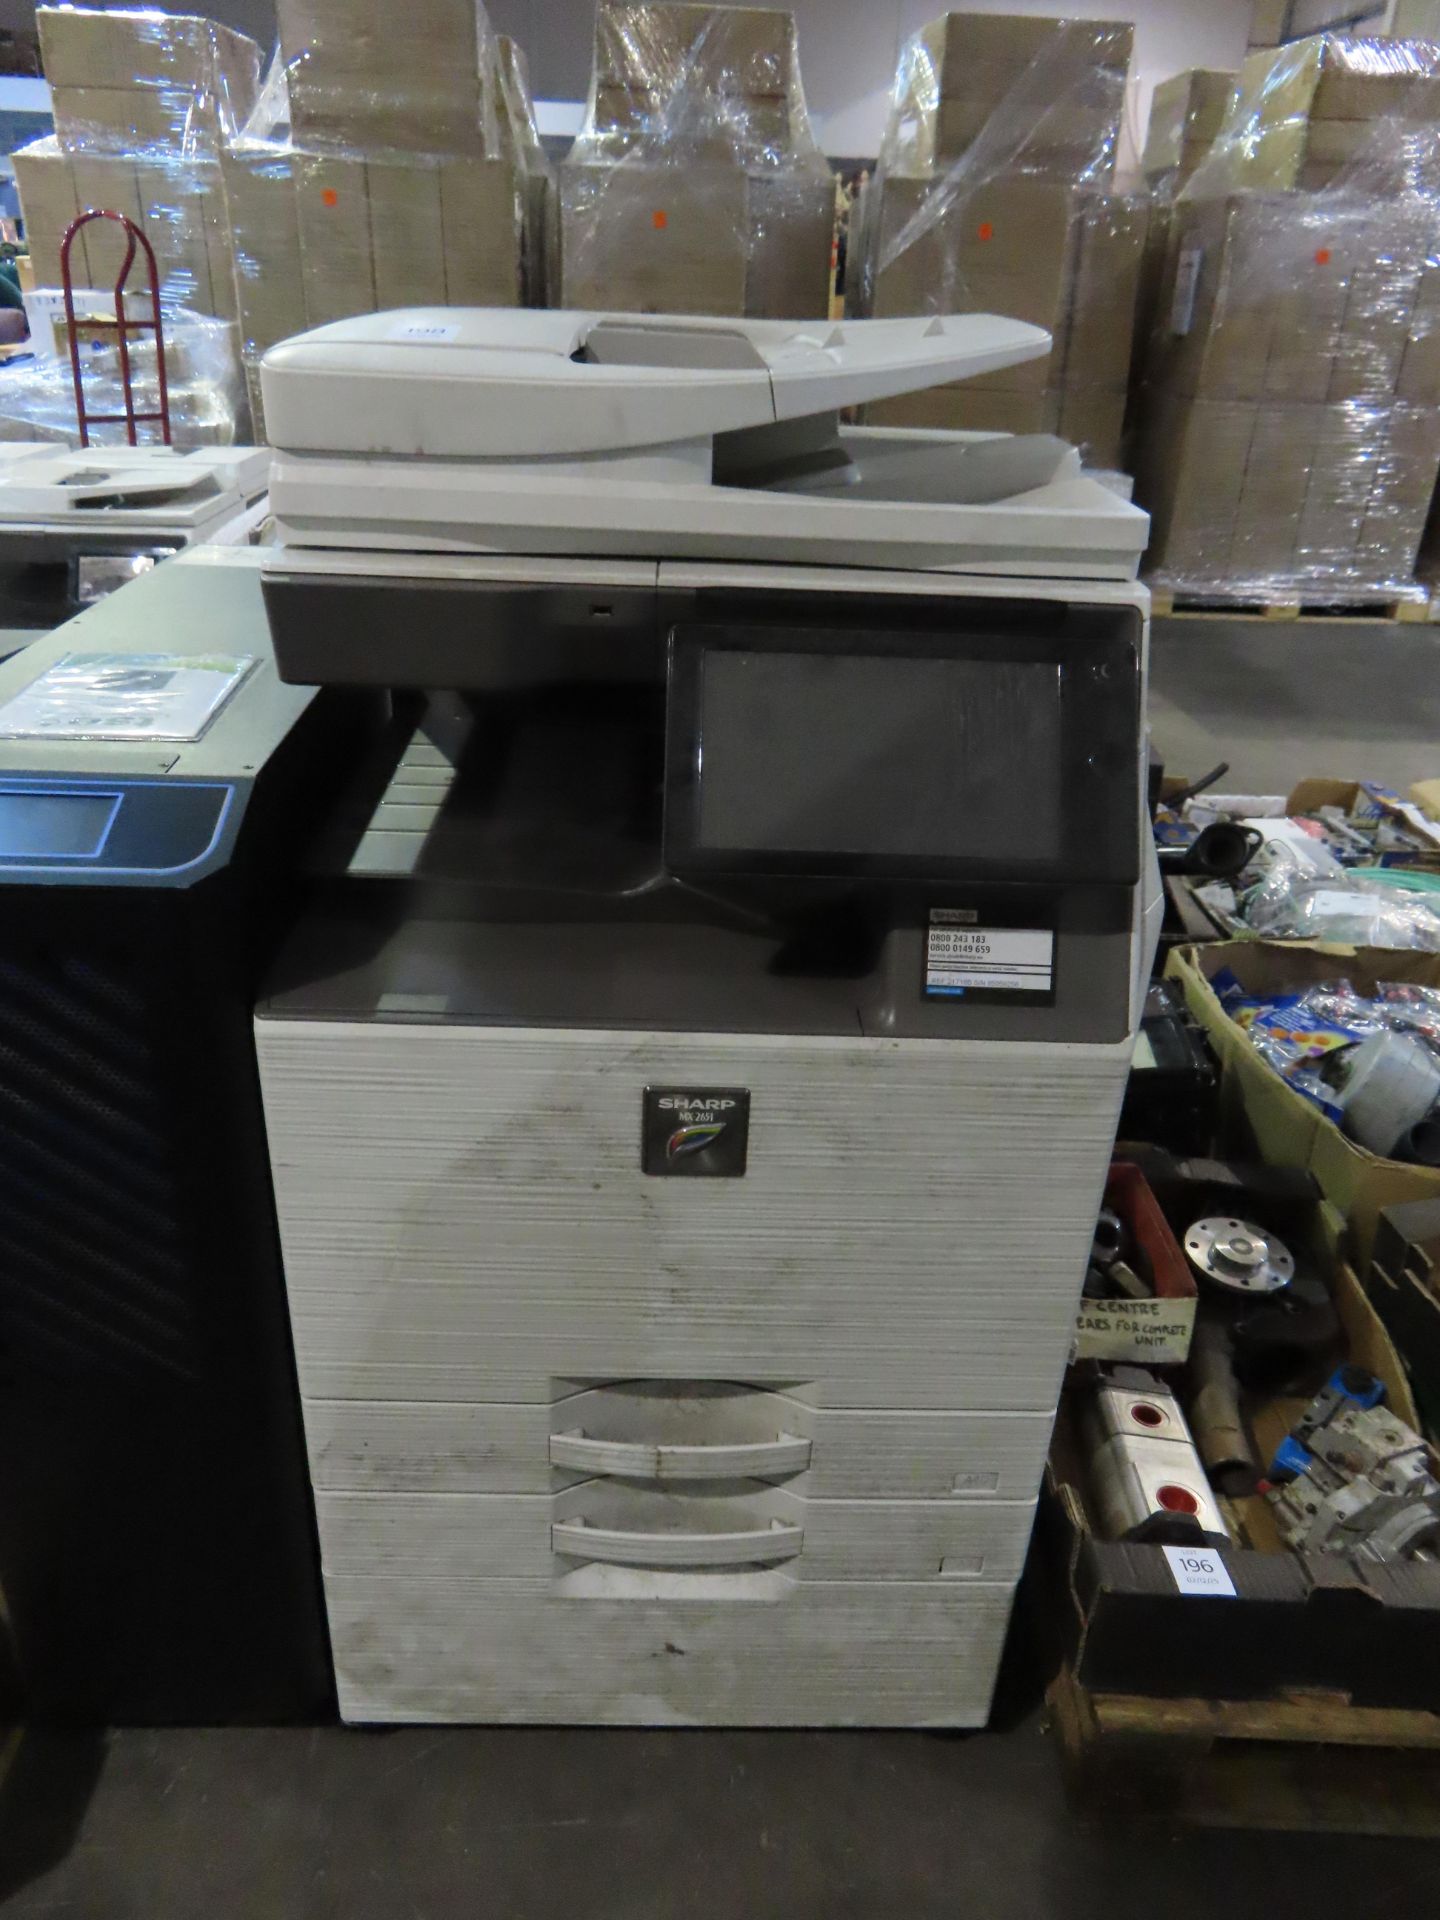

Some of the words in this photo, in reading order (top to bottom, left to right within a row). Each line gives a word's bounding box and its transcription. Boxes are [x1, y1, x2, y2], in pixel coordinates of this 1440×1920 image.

[930, 934, 951, 942] 0800
[953, 935, 968, 943] 243
[971, 935, 986, 943] 183
[930, 943, 950, 952] 0800
[952, 944, 973, 953] 0149
[658, 1098, 736, 1110] SHARP
[1096, 1301, 1160, 1315] CENTRE
[1115, 1319, 1140, 1332] FOR
[1179, 1558, 1214, 1573] 196
